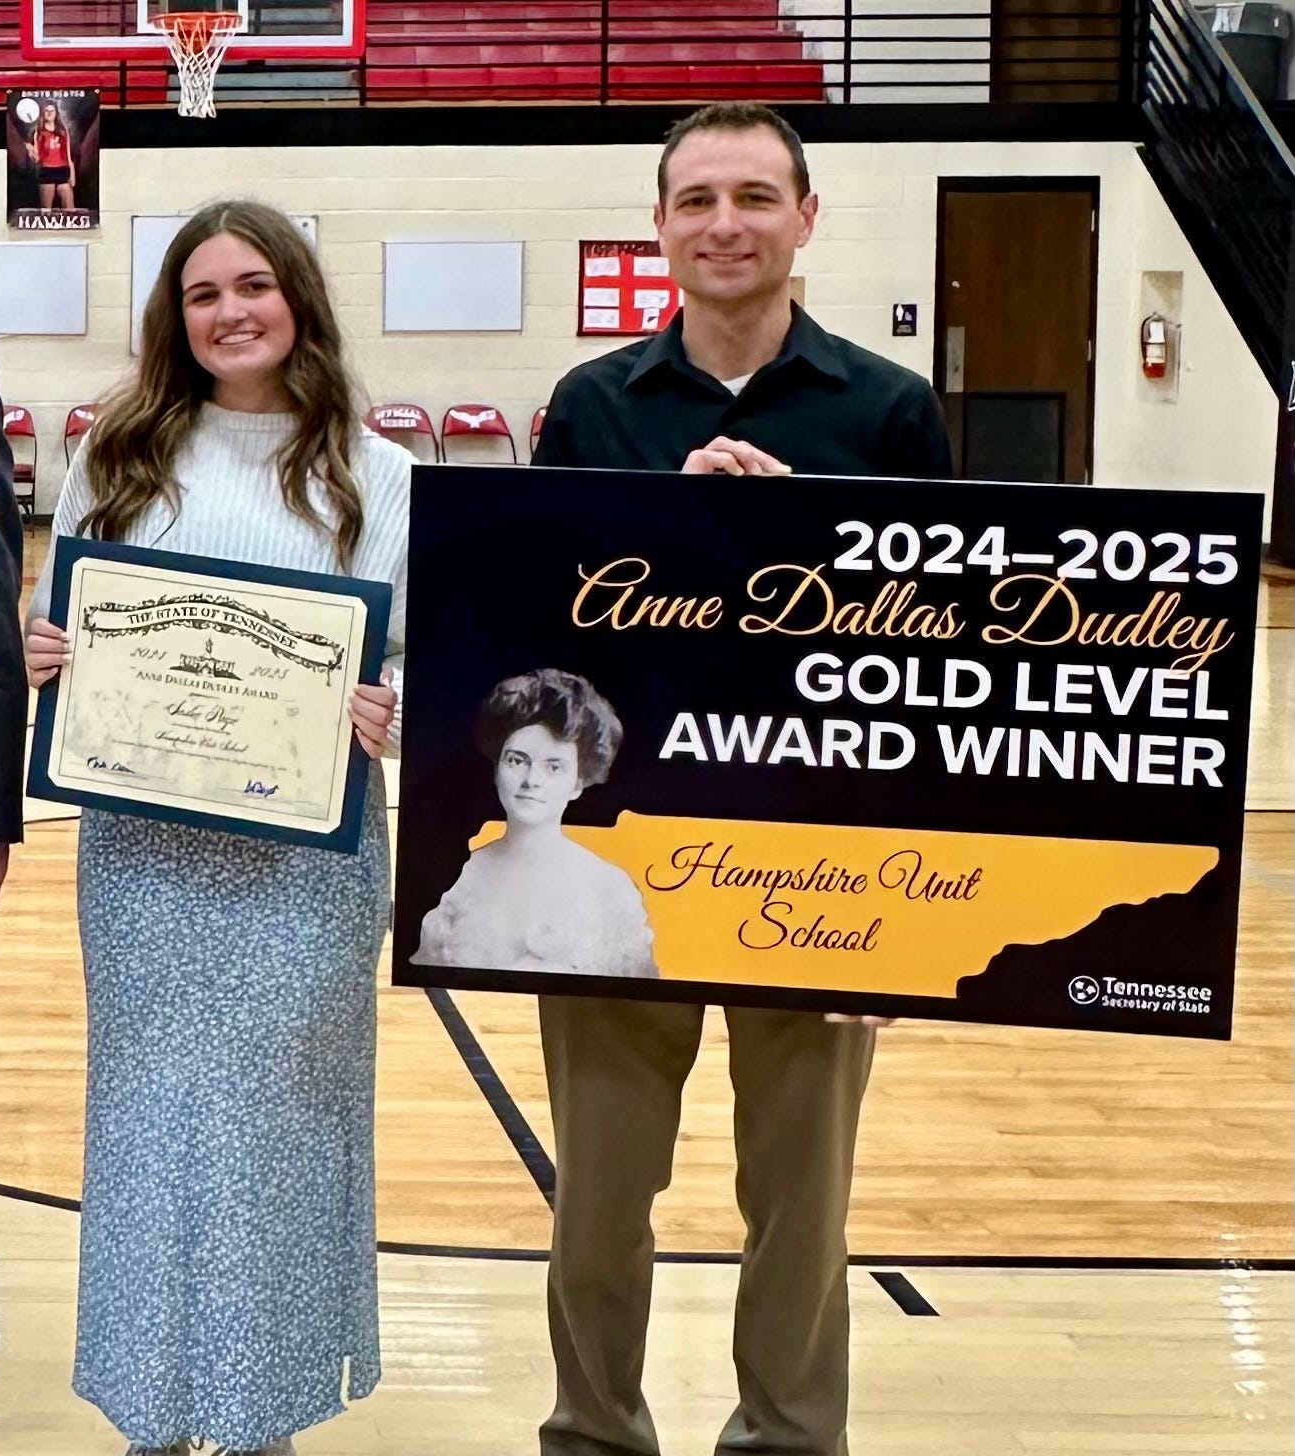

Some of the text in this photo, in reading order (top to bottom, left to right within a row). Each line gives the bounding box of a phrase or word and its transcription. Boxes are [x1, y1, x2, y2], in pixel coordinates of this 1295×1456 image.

[18, 215, 91, 230] HAWKS
[128, 611, 155, 625] THE
[200, 606, 220, 618] OF
[223, 610, 298, 650] TENNESSEE
[570, 557, 1233, 676] Anne Dallas Dudley
[794, 651, 1229, 721] GOLD LEVEL
[657, 712, 1227, 788] AWARD WINNER
[645, 841, 985, 910] Hampshire Unit
[736, 901, 882, 953] School
[1101, 995, 1160, 1012] Secretary
[1102, 976, 1212, 1001] Tennessee
